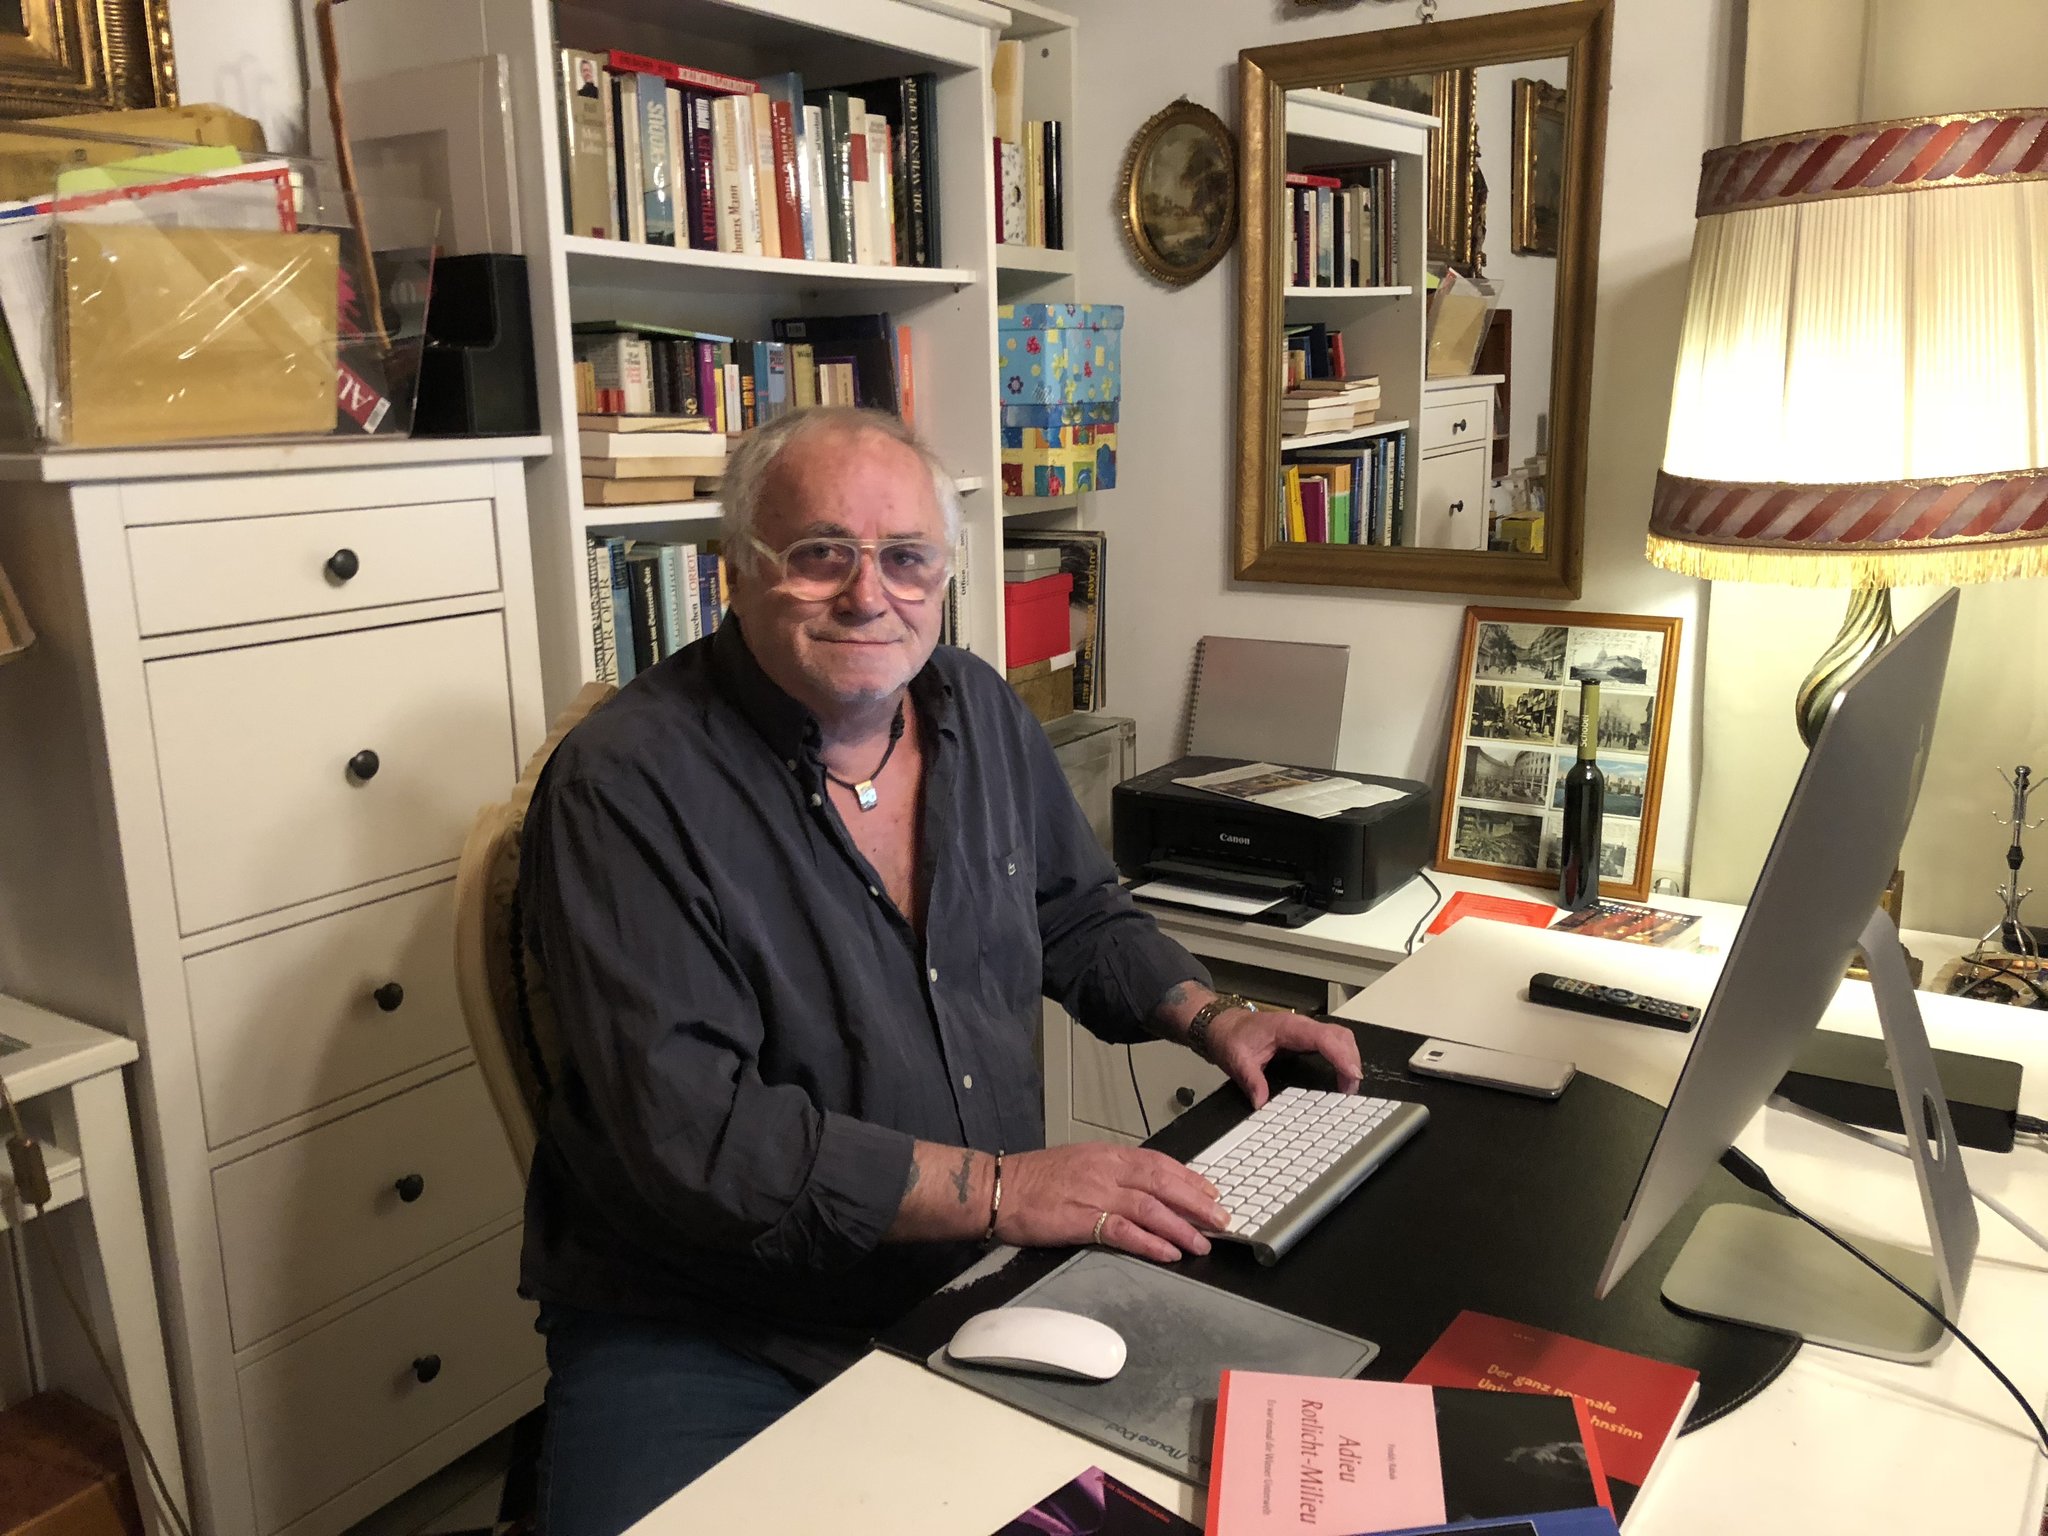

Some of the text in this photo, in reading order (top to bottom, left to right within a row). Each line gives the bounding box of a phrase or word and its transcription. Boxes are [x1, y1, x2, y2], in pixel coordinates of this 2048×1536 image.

[784, 175, 795, 204] JOHN
[727, 185, 743, 253] homas Mann
[686, 552, 699, 599] LORIOT
[1087, 549, 1097, 600] JULIANE
[599, 578, 613, 624] OPER
[1219, 832, 1250, 846] Canon
[1487, 1363, 1617, 1415] Der ganz nomale
[1138, 1434, 1188, 1460] Mouse
[1590, 1415, 1644, 1441] hnsinn
[1263, 1449, 1275, 1472] Wiener
[1299, 1399, 1325, 1525] Rotlicht-Milieu
[1338, 1434, 1362, 1484] Adieu
[1262, 1473, 1275, 1516] Unterwelt
